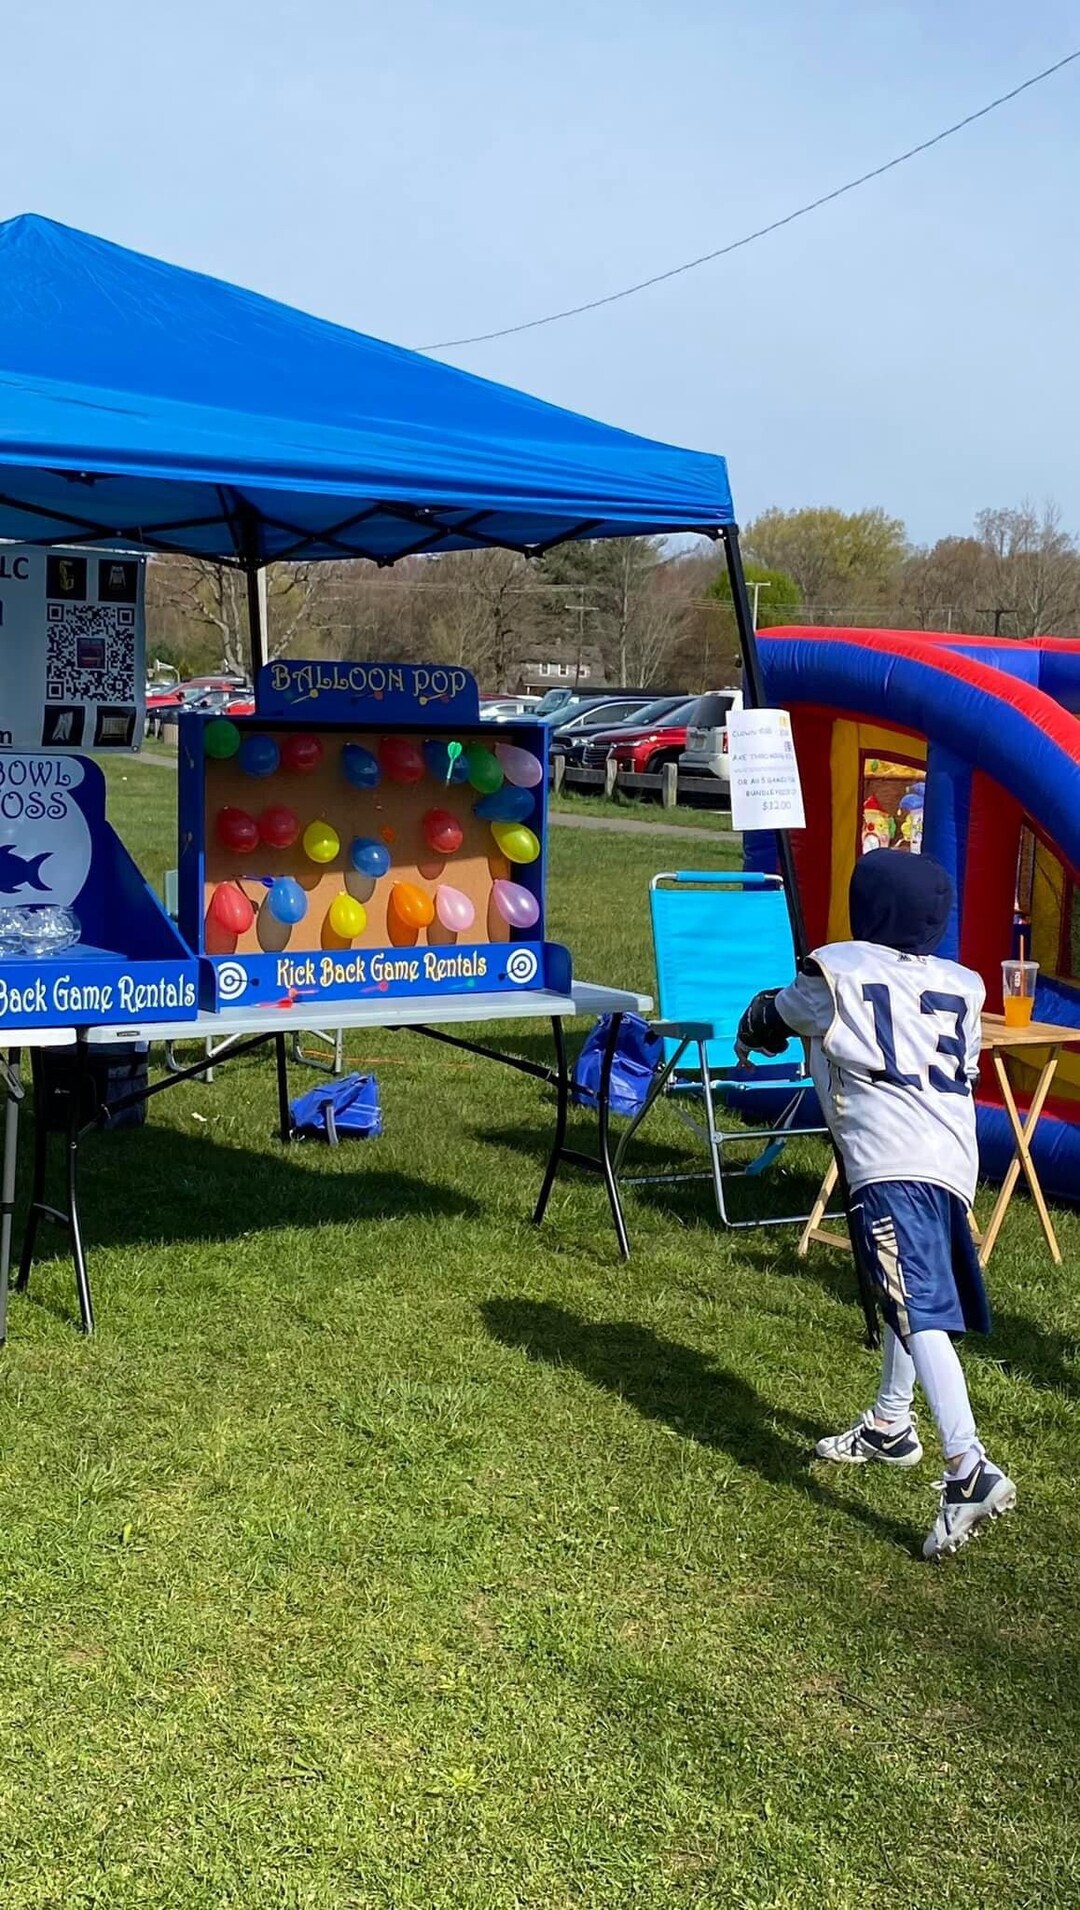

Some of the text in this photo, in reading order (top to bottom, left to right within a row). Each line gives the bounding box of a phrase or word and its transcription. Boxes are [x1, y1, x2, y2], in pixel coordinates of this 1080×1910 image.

[271, 663, 467, 698] BALLOON POP
[0, 789, 68, 820] OSS
[276, 949, 487, 988] Kick Back Game Rentals
[0, 973, 196, 1017] Back Game Rentals
[862, 984, 970, 1096] 13
